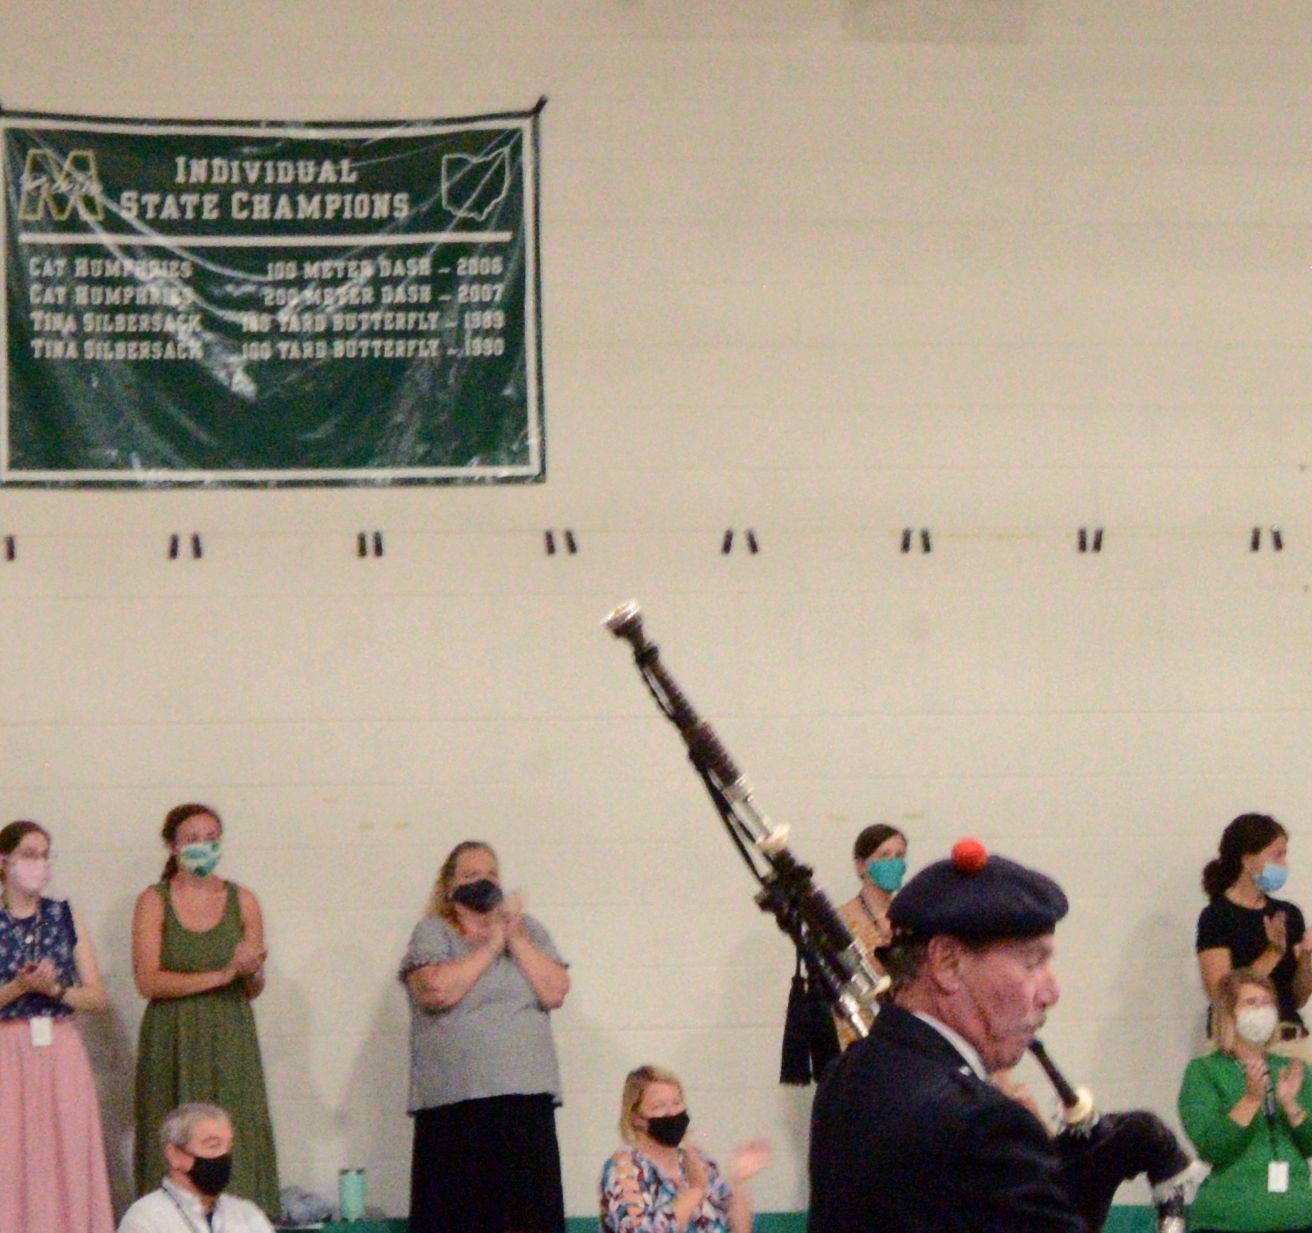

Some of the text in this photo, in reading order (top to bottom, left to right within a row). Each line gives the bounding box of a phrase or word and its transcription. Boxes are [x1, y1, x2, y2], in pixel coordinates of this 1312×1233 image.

[174, 156, 359, 184] INDIVIDUAL
[120, 191, 411, 220] STATE CHAMPIONS
[29, 256, 68, 278] CAT
[303, 258, 376, 280] METER
[379, 256, 432, 278] DASH
[29, 283, 68, 305] CAT
[381, 283, 432, 304] DASH
[457, 284, 505, 303] 2007
[30, 311, 77, 332] TINA
[332, 310, 440, 331] BUTTERFLY
[30, 338, 80, 359] TINA
[277, 339, 329, 360] YARD
[333, 338, 441, 358] BUTTERFLY
